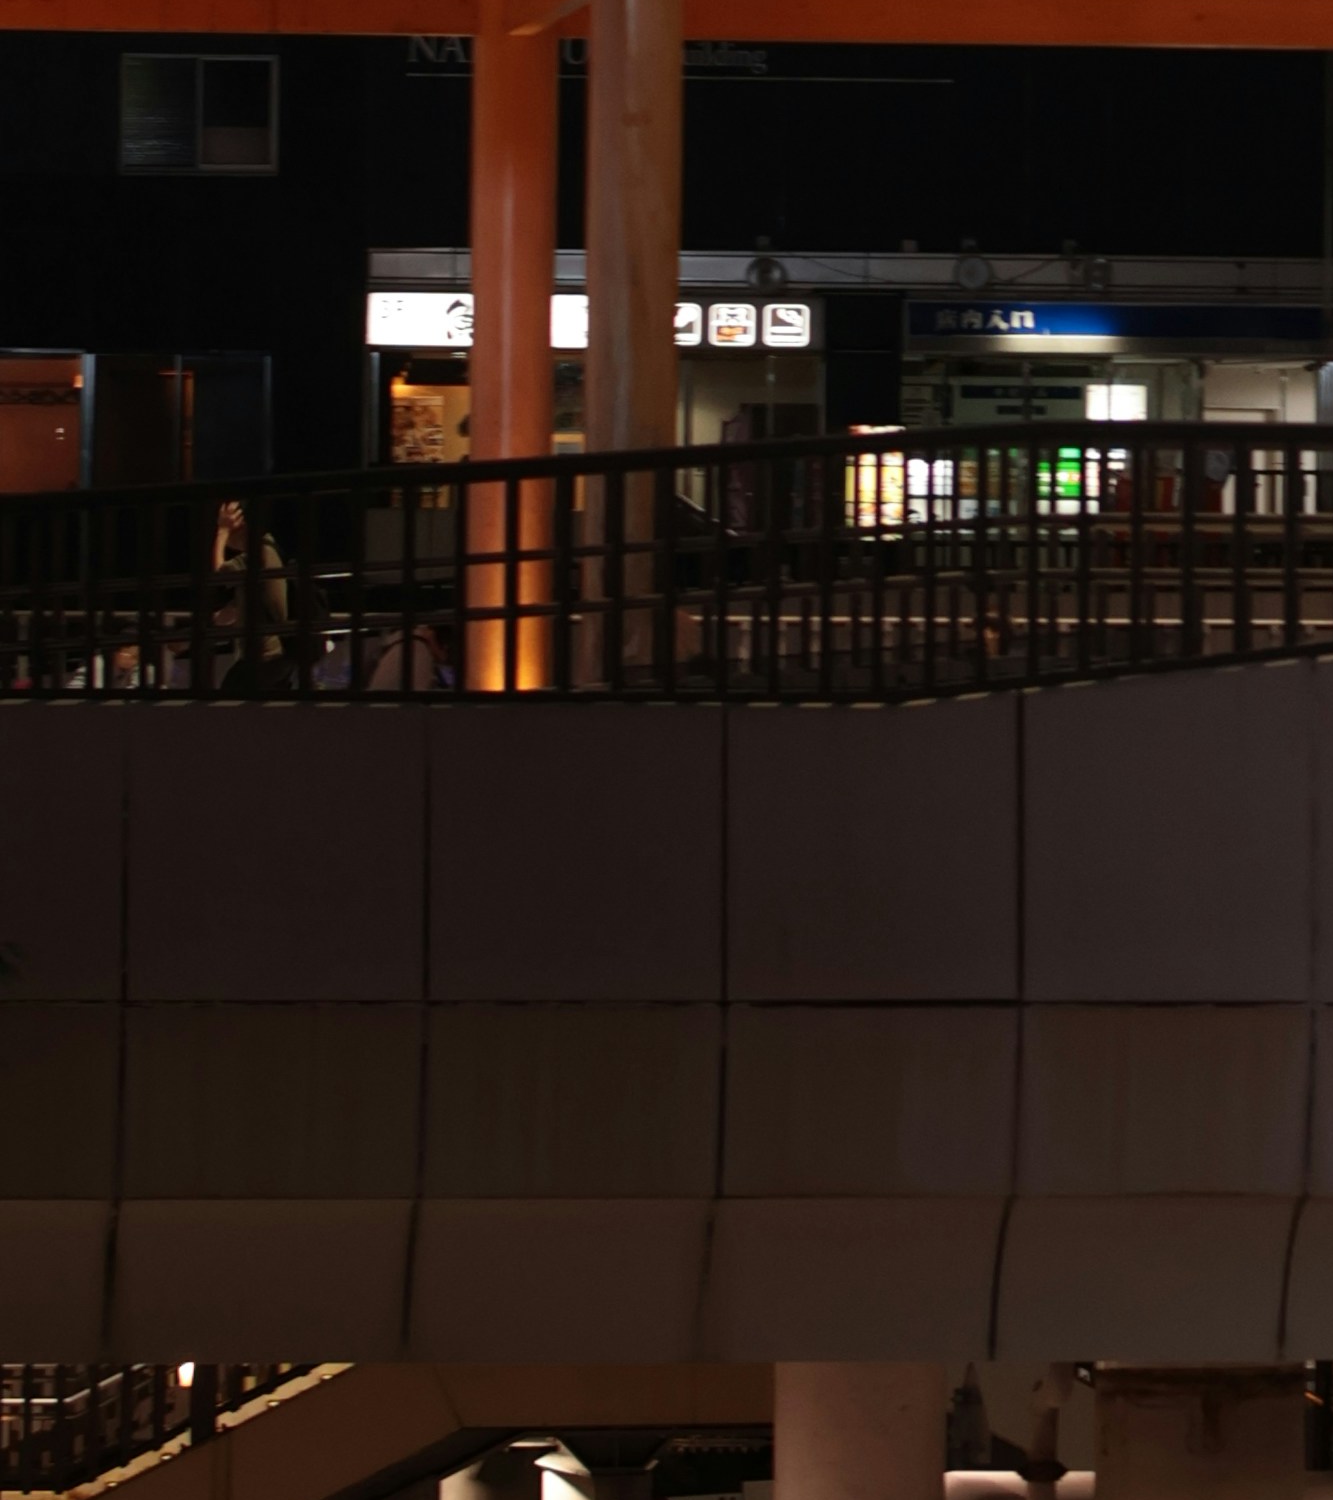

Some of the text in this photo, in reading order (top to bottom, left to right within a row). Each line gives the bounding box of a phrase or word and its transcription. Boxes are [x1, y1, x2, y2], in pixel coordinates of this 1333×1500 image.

[682, 42, 770, 75] uilding
[934, 308, 1036, 332] 店内入口
